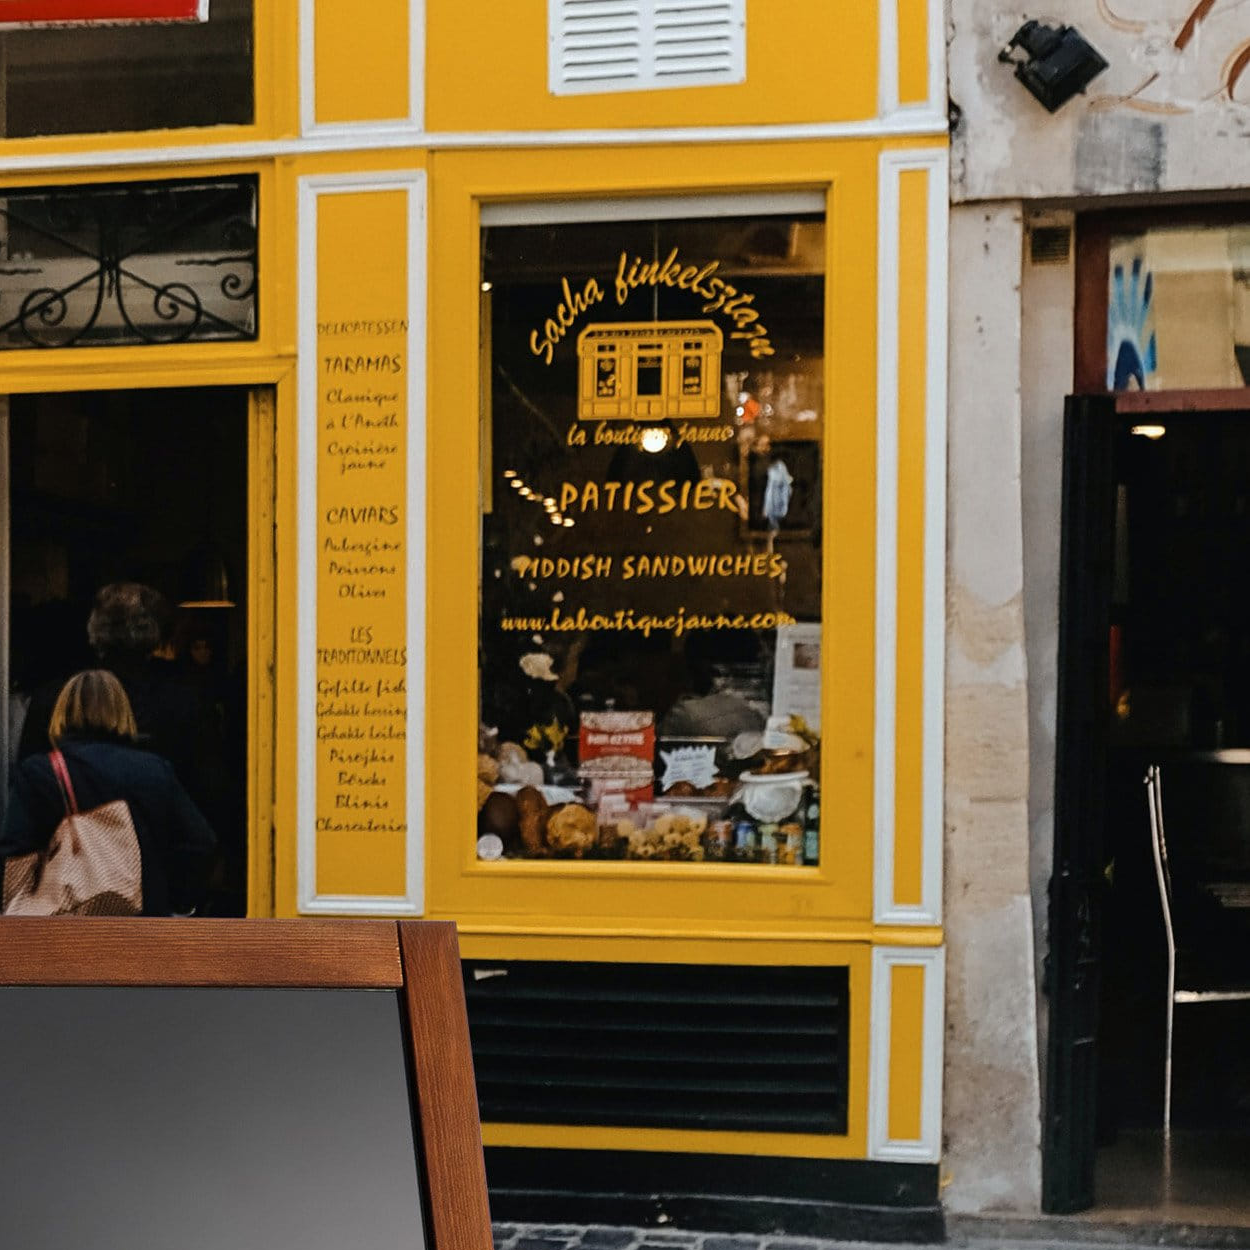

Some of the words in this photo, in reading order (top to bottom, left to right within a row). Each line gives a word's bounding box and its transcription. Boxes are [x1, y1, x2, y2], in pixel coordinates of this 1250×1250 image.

[530, 277, 605, 366] Sacha
[325, 355, 400, 373] TARAMAS
[567, 421, 591, 446] la
[595, 420, 672, 450] bouti
[677, 422, 732, 448] jaune
[560, 478, 741, 515] PATISSIER
[327, 506, 398, 524] CAVIARS
[623, 552, 783, 580] SANDWICHES
[501, 607, 797, 636] www.laboutiquejaune.com
[351, 627, 372, 644] LES
[377, 680, 406, 697] fish
[336, 794, 388, 809] Blinis
